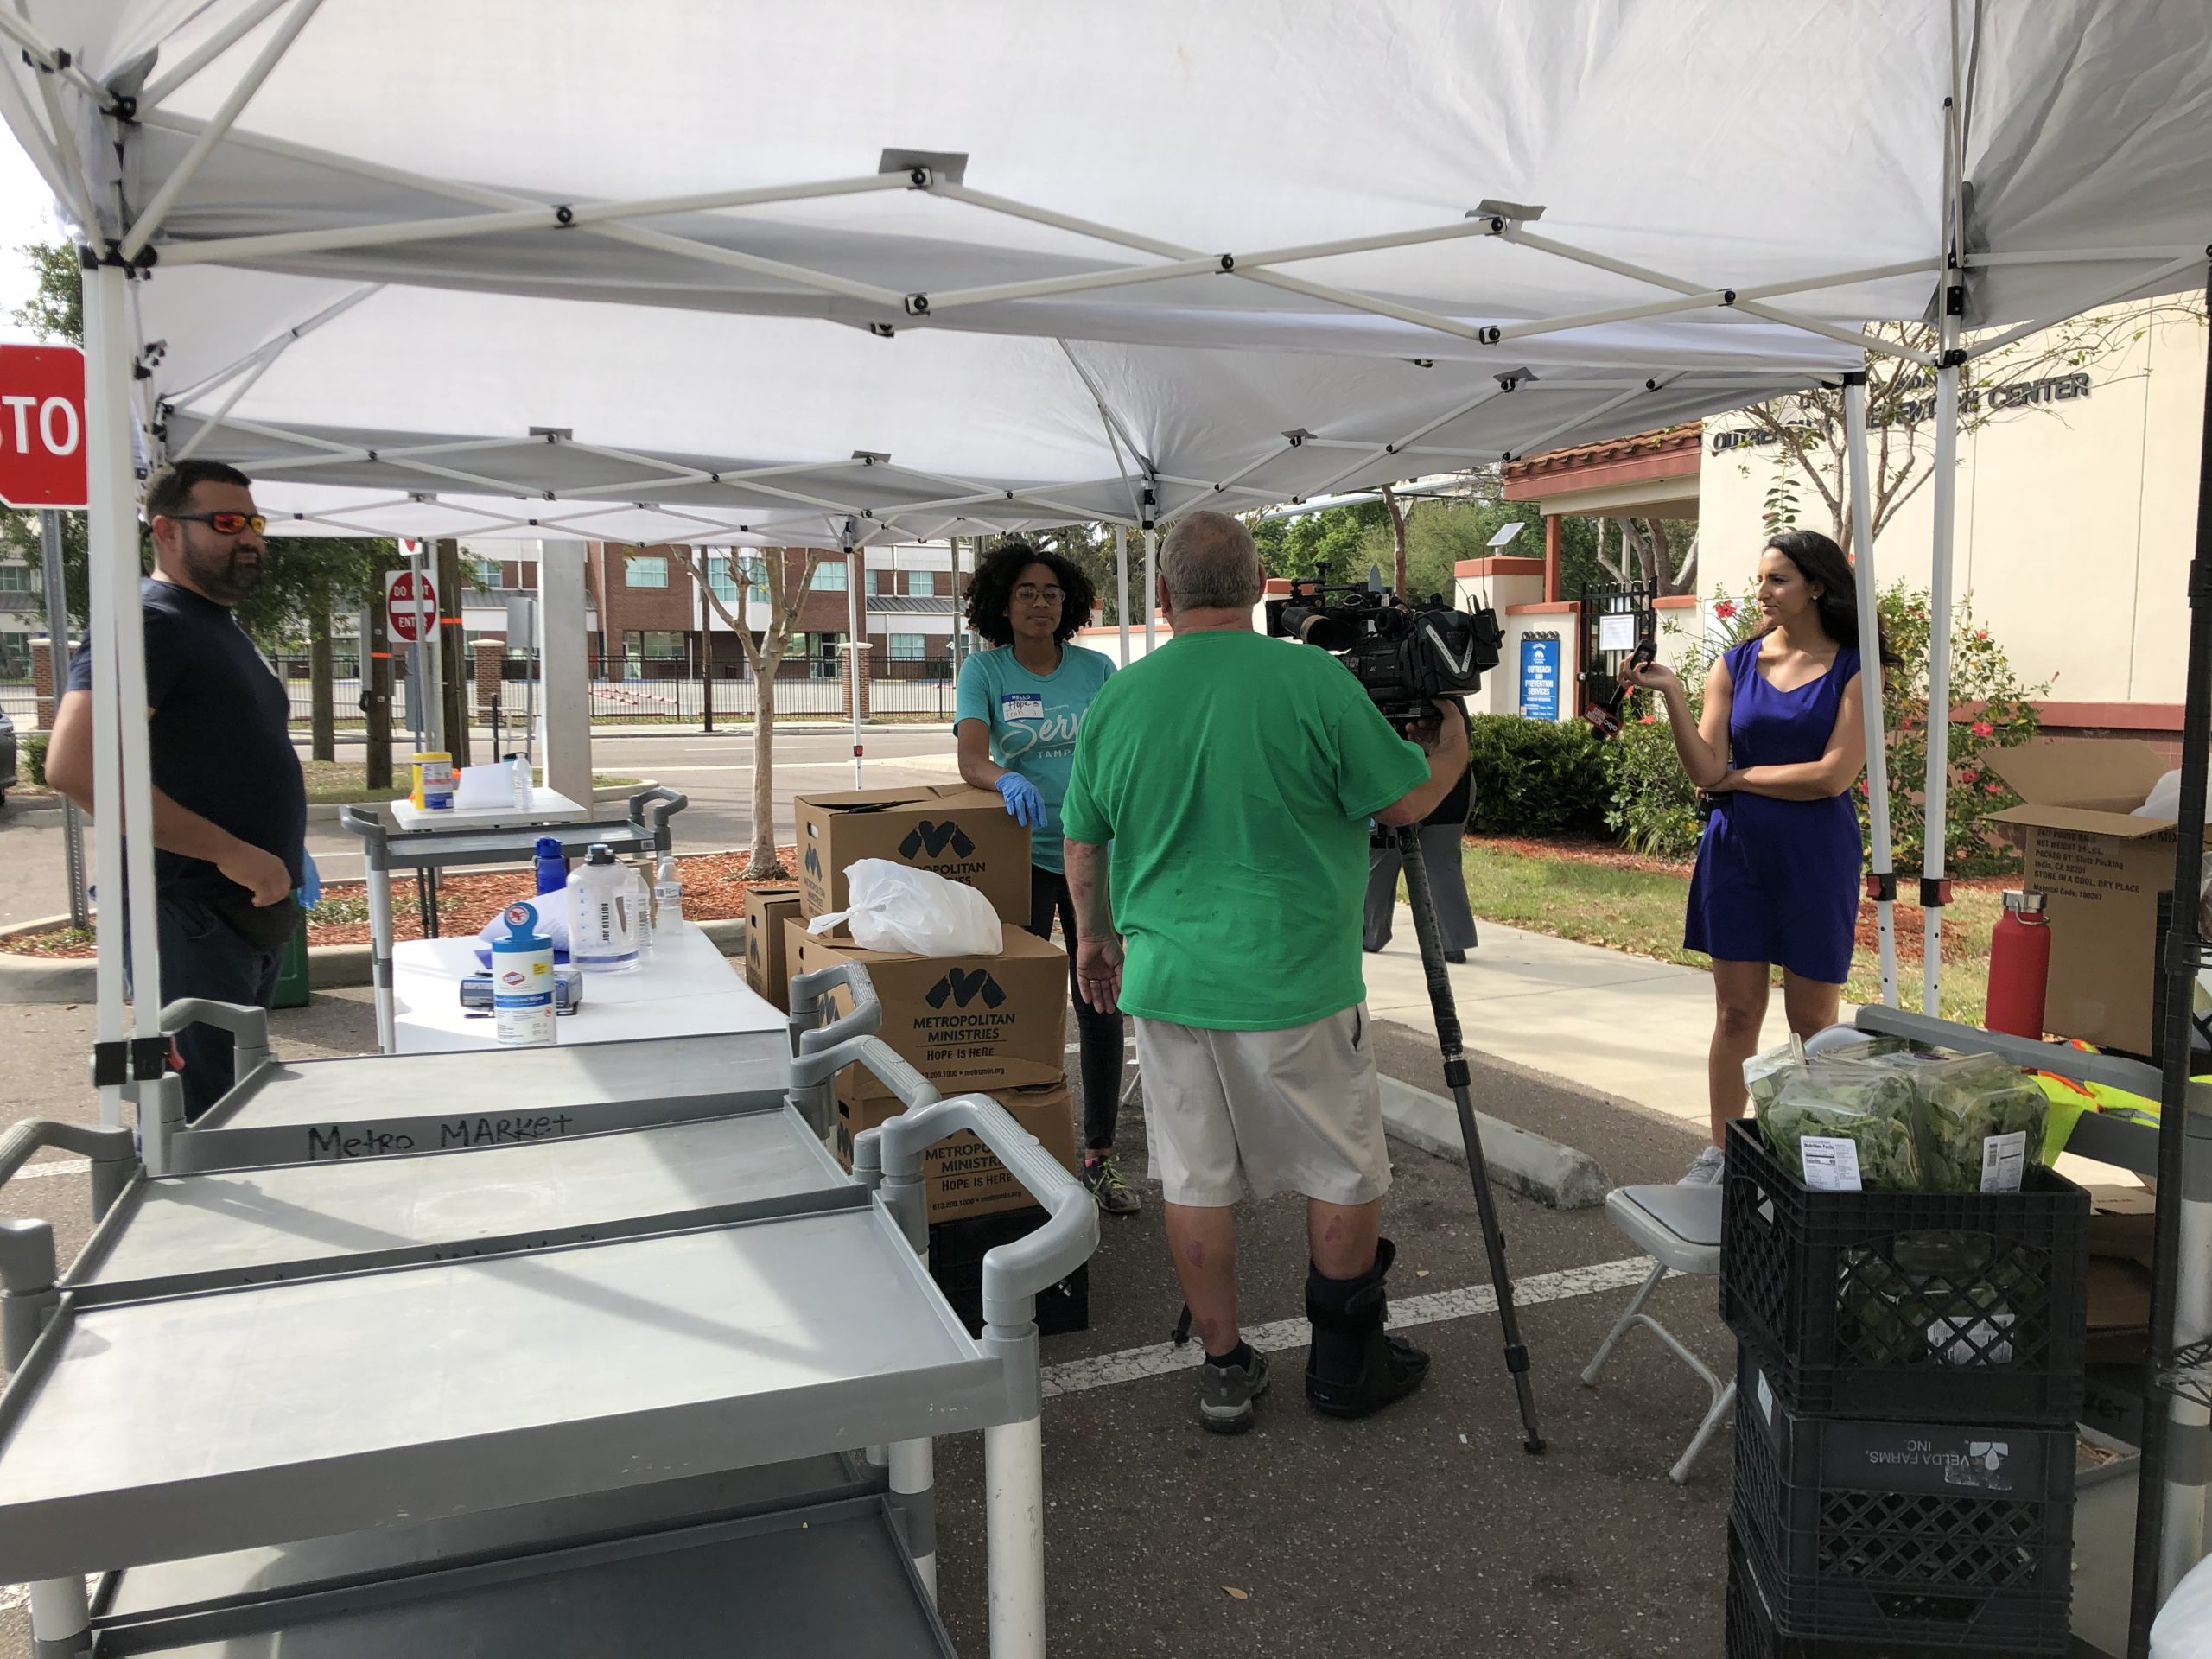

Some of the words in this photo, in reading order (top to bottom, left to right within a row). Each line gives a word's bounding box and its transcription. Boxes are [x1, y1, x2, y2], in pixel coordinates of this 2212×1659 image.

[1988, 372, 2090, 409] CENTER
[0, 395, 80, 456] TO
[393, 586, 407, 597] DO
[398, 617, 428, 629] ENTR
[1527, 665, 1552, 674] OUTREACH
[1525, 679, 1554, 688] PREVENTION
[1008, 700, 1032, 710] Hope
[1603, 719, 1618, 732] abc
[1000, 707, 1088, 760] Serv
[1037, 749, 1073, 759] TAMP
[2035, 849, 2062, 861] PACKED
[2095, 857, 2124, 871] Packing
[918, 862, 986, 874] OPOLITAN
[2055, 862, 2064, 872] CA
[2065, 865, 2086, 874] 92201
[2033, 871, 2056, 880] STORE
[2067, 874, 2073, 883] A
[2075, 876, 2096, 887] COOL,
[2098, 879, 2113, 889] DRY
[2115, 882, 2140, 893] PLACE
[601, 930, 610, 942] JOY
[913, 1013, 1016, 1029] METROPOLITAN
[927, 1028, 1000, 1043] MINISTRIES
[926, 1049, 953, 1061] HOPE
[957, 1047, 966, 1058] IS
[969, 1046, 995, 1058] HERE
[922, 1070, 958, 1079] 13.209.1000
[963, 1067, 1005, 1077] metromin.org
[925, 1142, 993, 1161] METROPO
[941, 1155, 1002, 1173] MINISTRI
[942, 1177, 969, 1192] HOPE
[974, 1175, 983, 1187] IS
[986, 1173, 1012, 1186] HERE
[1903, 1440, 1932, 1452] INC.
[1865, 1450, 1919, 1465] FARMS,
[1921, 1453, 1970, 1467] VELDA
